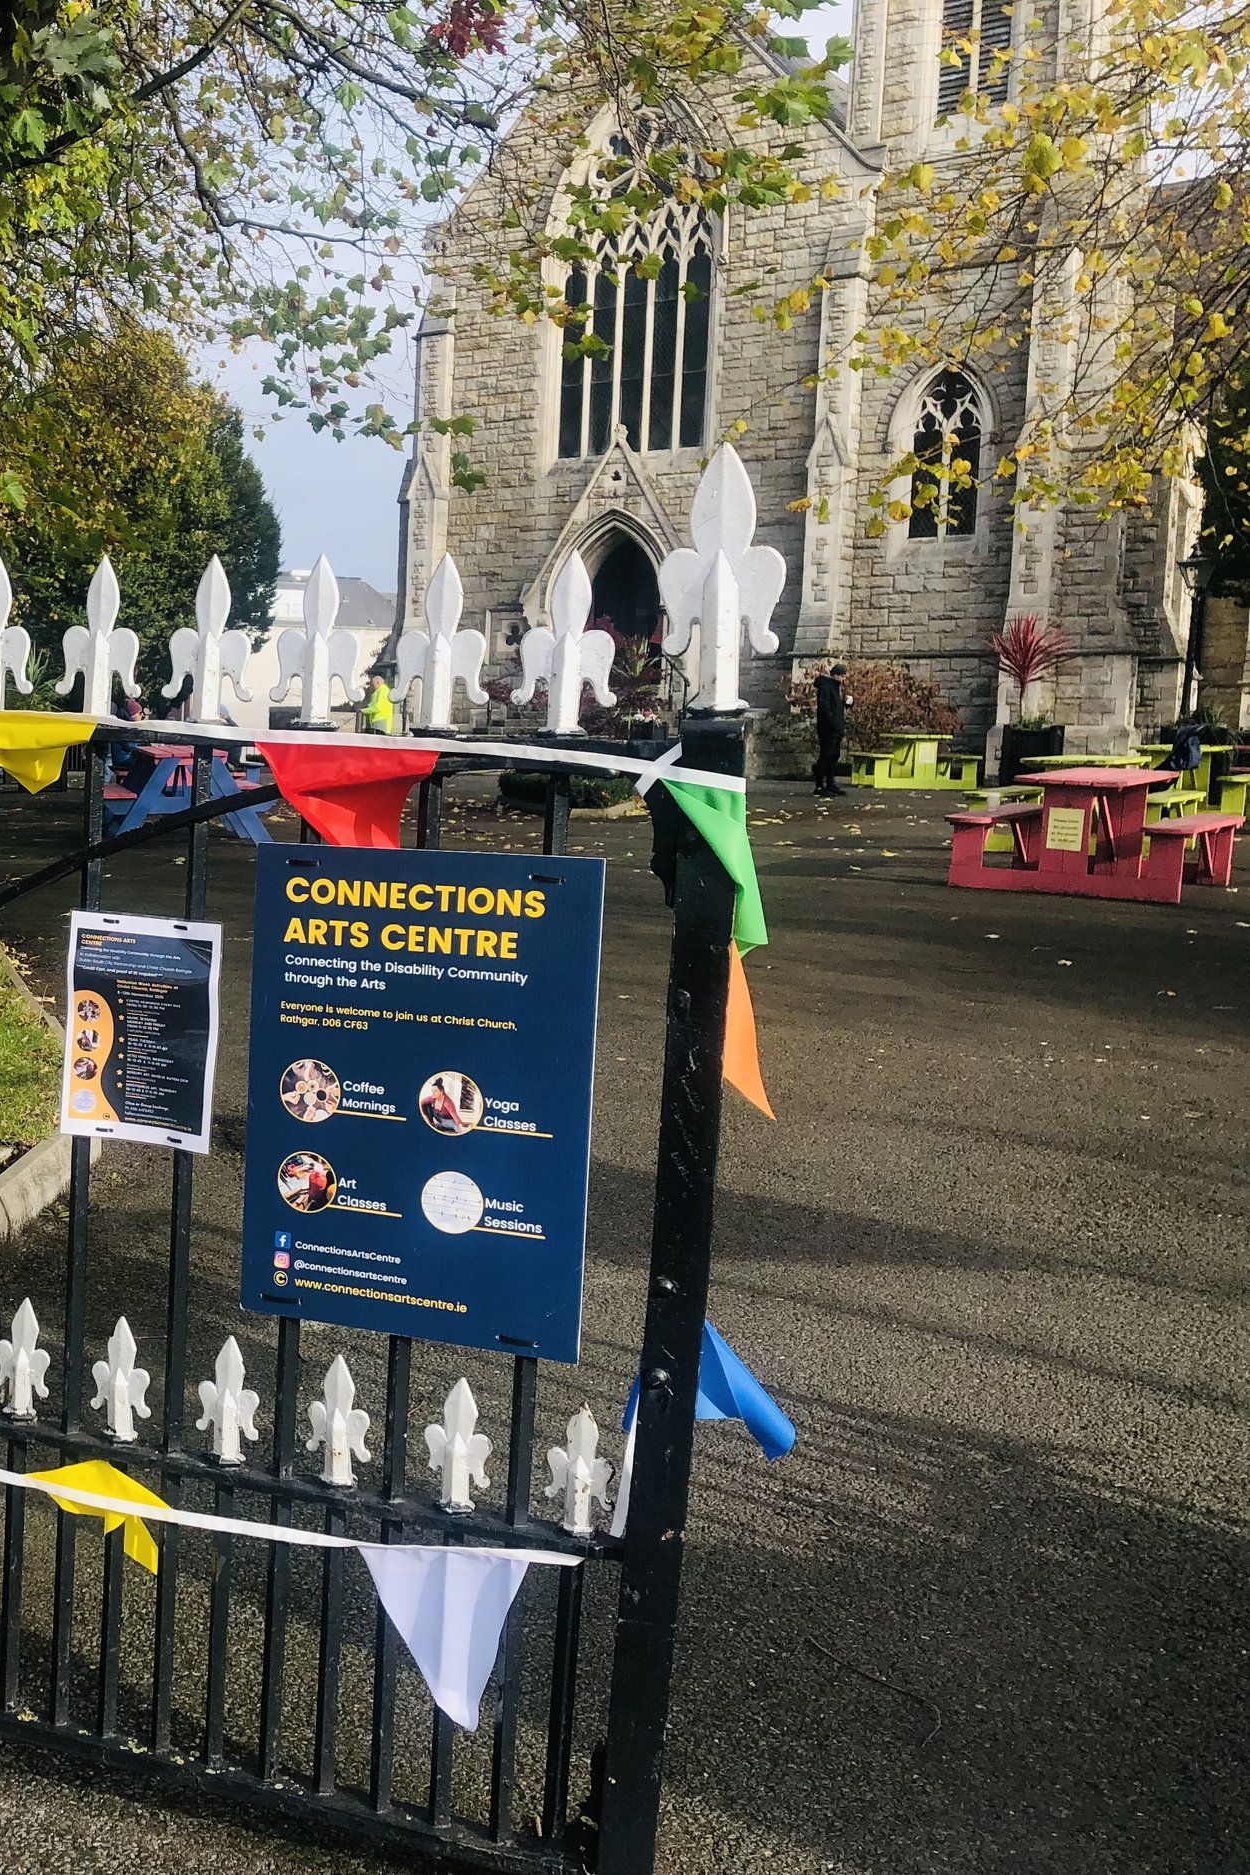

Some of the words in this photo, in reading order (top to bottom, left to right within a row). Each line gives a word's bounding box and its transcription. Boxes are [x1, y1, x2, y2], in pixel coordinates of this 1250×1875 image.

[285, 875, 547, 919] CONNECTIONS
[283, 917, 370, 948] ARTS
[380, 923, 519, 960] CENTRE
[285, 954, 357, 973] Connecting
[360, 958, 382, 972] the
[385, 961, 445, 980] Disability
[447, 966, 529, 987] Community
[284, 972, 333, 988] through
[336, 975, 357, 988] the
[360, 978, 386, 991] Arts
[280, 1000, 324, 1015] Everyone
[326, 1004, 334, 1014] is
[336, 1006, 381, 1018] welcome
[383, 1009, 393, 1019] to
[394, 1010, 414, 1023] join
[416, 1014, 428, 1022] us
[430, 1014, 442, 1024] at
[444, 1015, 475, 1027] Christ
[477, 1018, 518, 1031] Church,
[280, 1014, 320, 1028] Rathgar,
[322, 1018, 341, 1028] D06
[344, 1020, 369, 1031] CF63
[342, 1080, 385, 1095] Coffee
[342, 1097, 396, 1115] Mornings
[484, 1097, 520, 1115] Yoga
[483, 1116, 537, 1132] Classes
[338, 1177, 357, 1190] Art
[337, 1195, 387, 1212] Classes
[485, 1197, 524, 1213] Music
[484, 1216, 543, 1234] Sessions
[295, 1241, 402, 1265] ConnectionsArtsCentre
[293, 1259, 408, 1285] @connectionsartscentre
[294, 1277, 468, 1313] www.connectionsartscentre.ie
